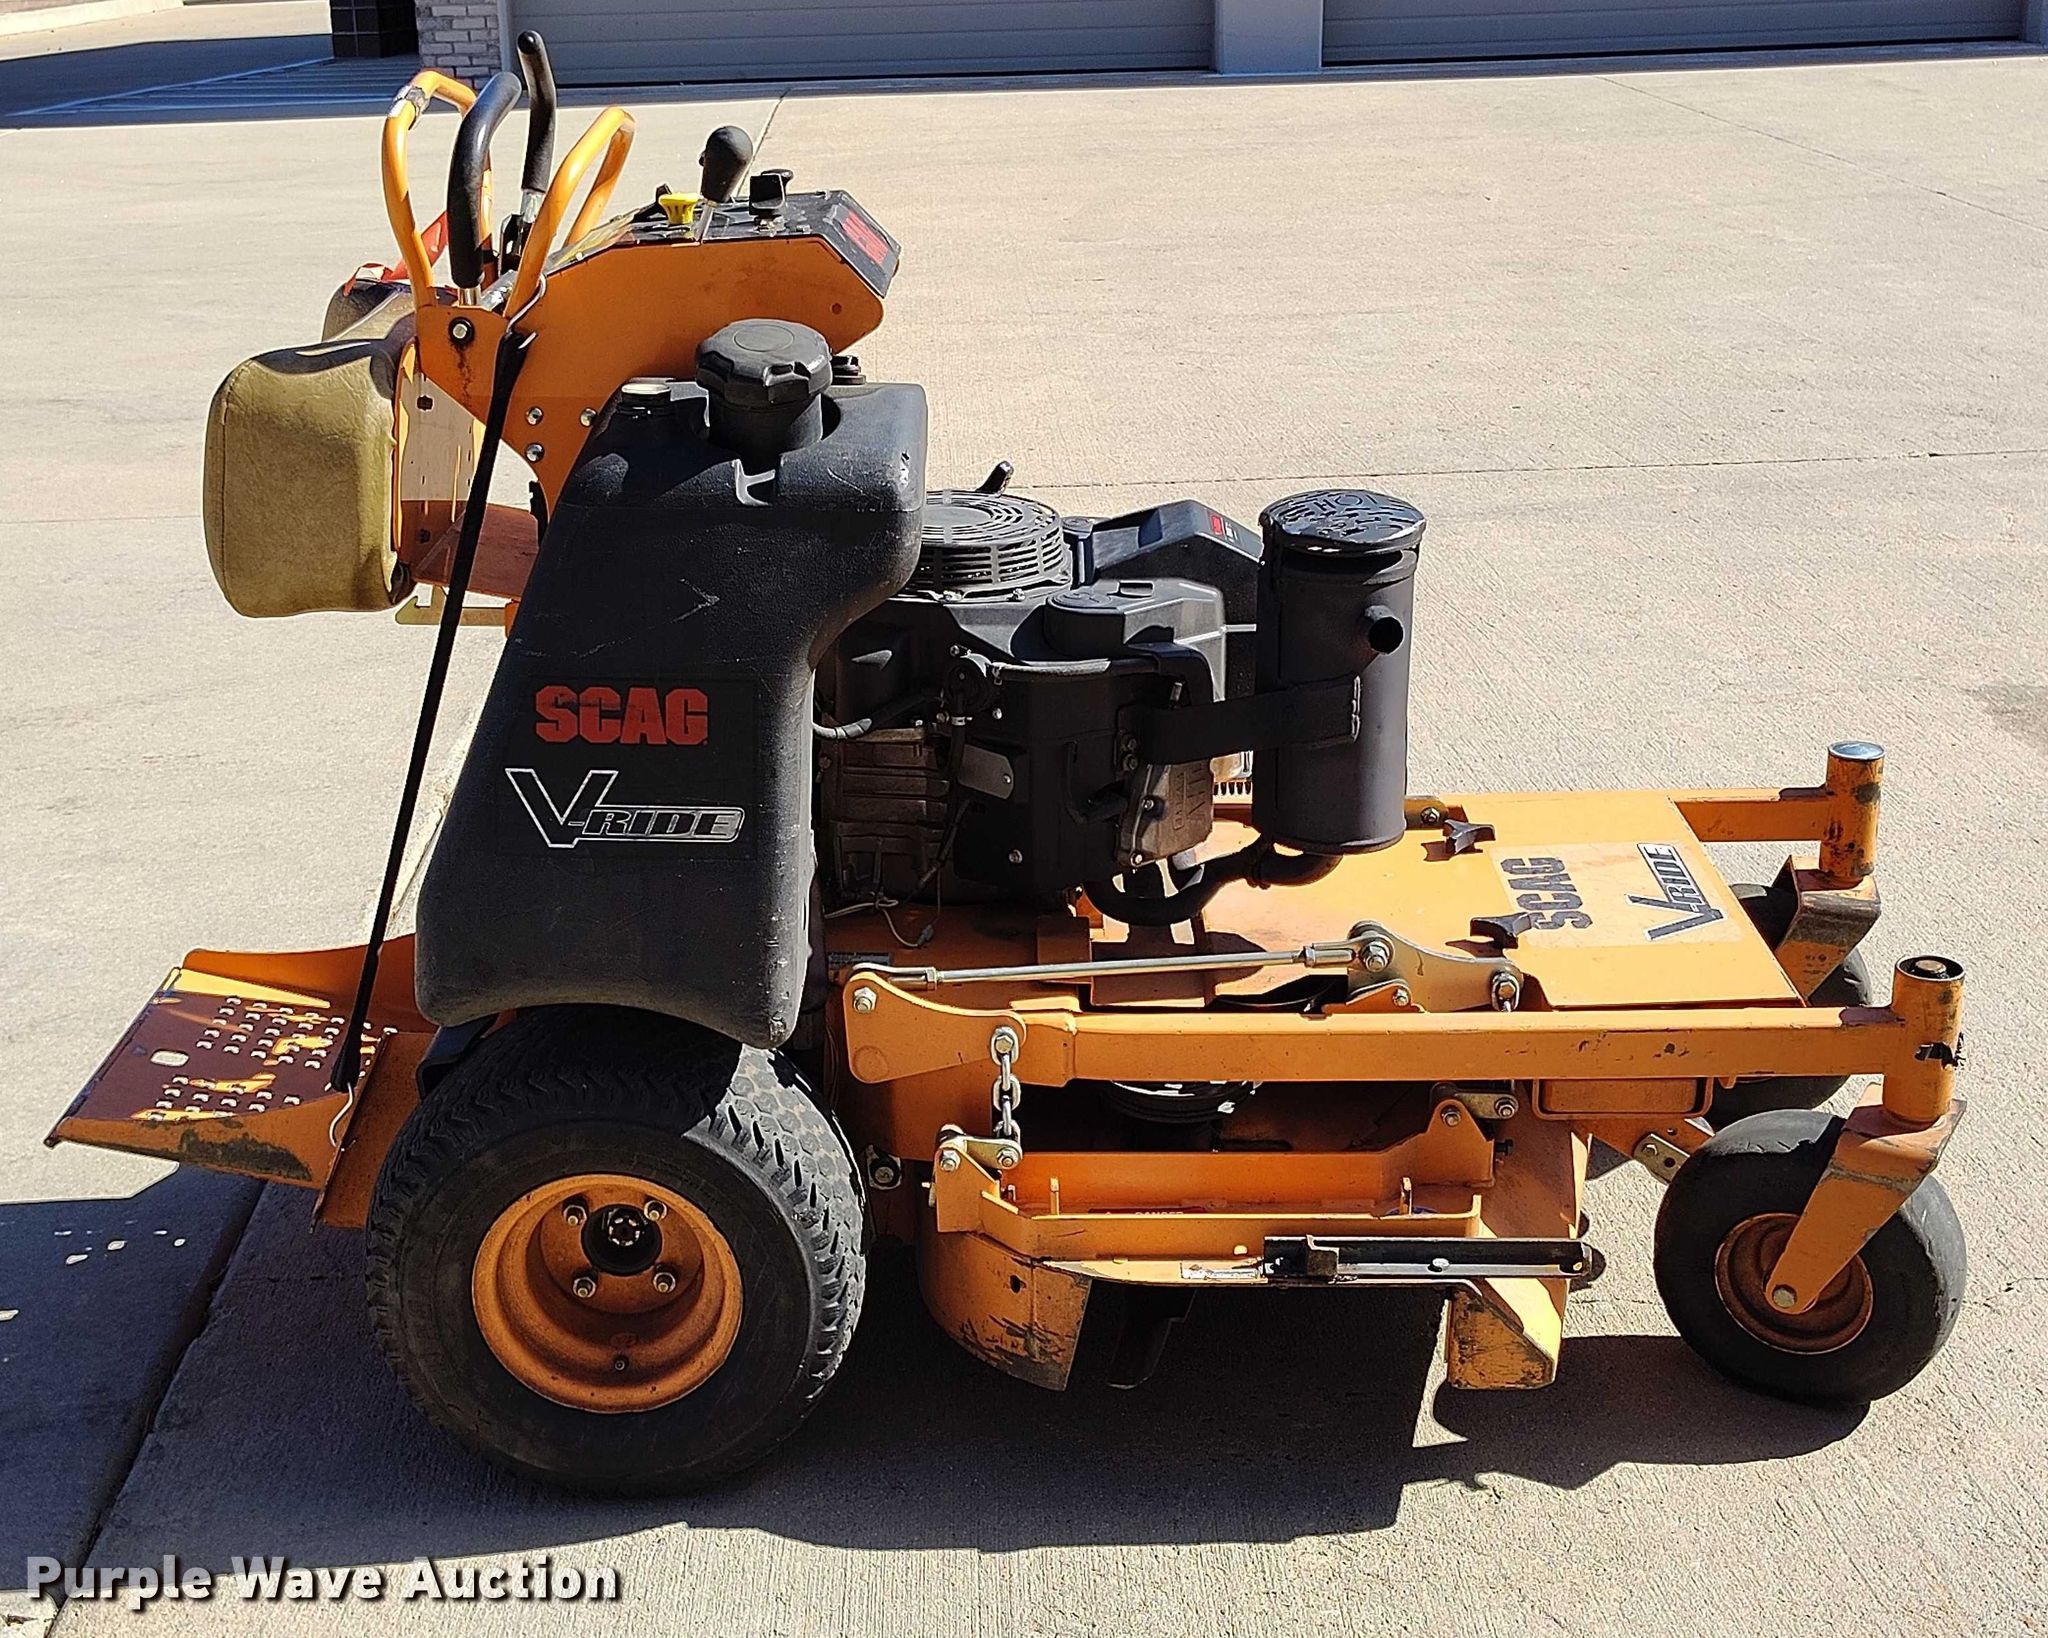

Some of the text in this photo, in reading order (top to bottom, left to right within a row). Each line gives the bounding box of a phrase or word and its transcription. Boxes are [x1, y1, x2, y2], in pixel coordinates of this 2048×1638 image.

[535, 684, 708, 746] SCAG
[504, 768, 745, 849] V-RIDE
[1500, 857, 1593, 931] SCAG
